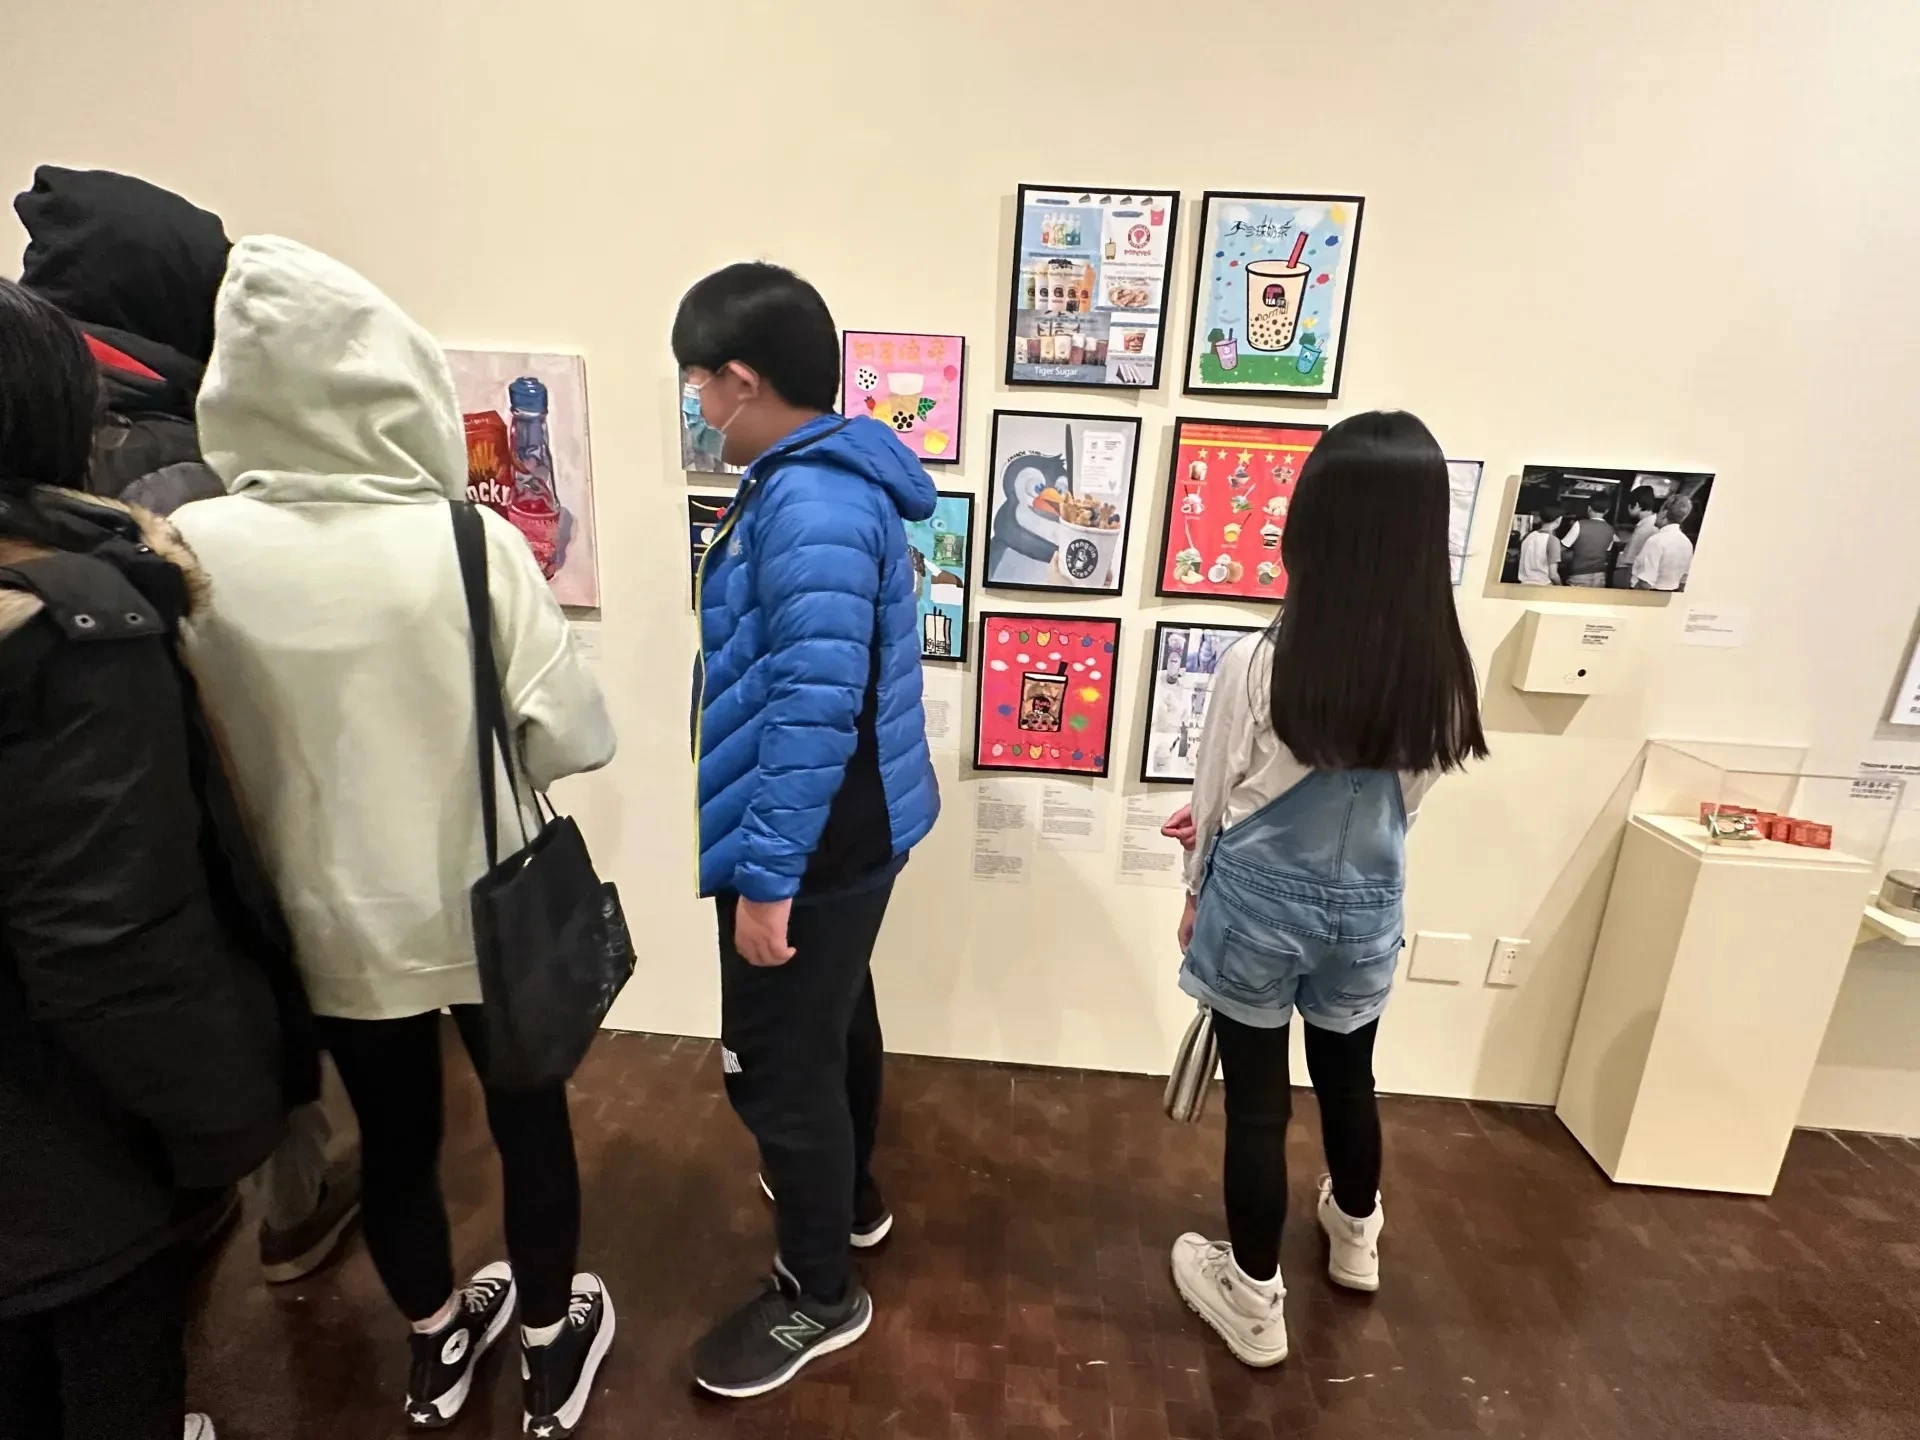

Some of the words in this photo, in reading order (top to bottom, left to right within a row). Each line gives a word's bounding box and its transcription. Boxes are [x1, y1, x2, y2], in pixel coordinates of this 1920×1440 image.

[1034, 365, 1054, 377] Tiger
[1055, 367, 1079, 377] Sugar
[465, 478, 512, 508] ocky
[1070, 541, 1097, 559] Penguin
[1071, 564, 1094, 578] Cream
[769, 1310, 826, 1351] N
